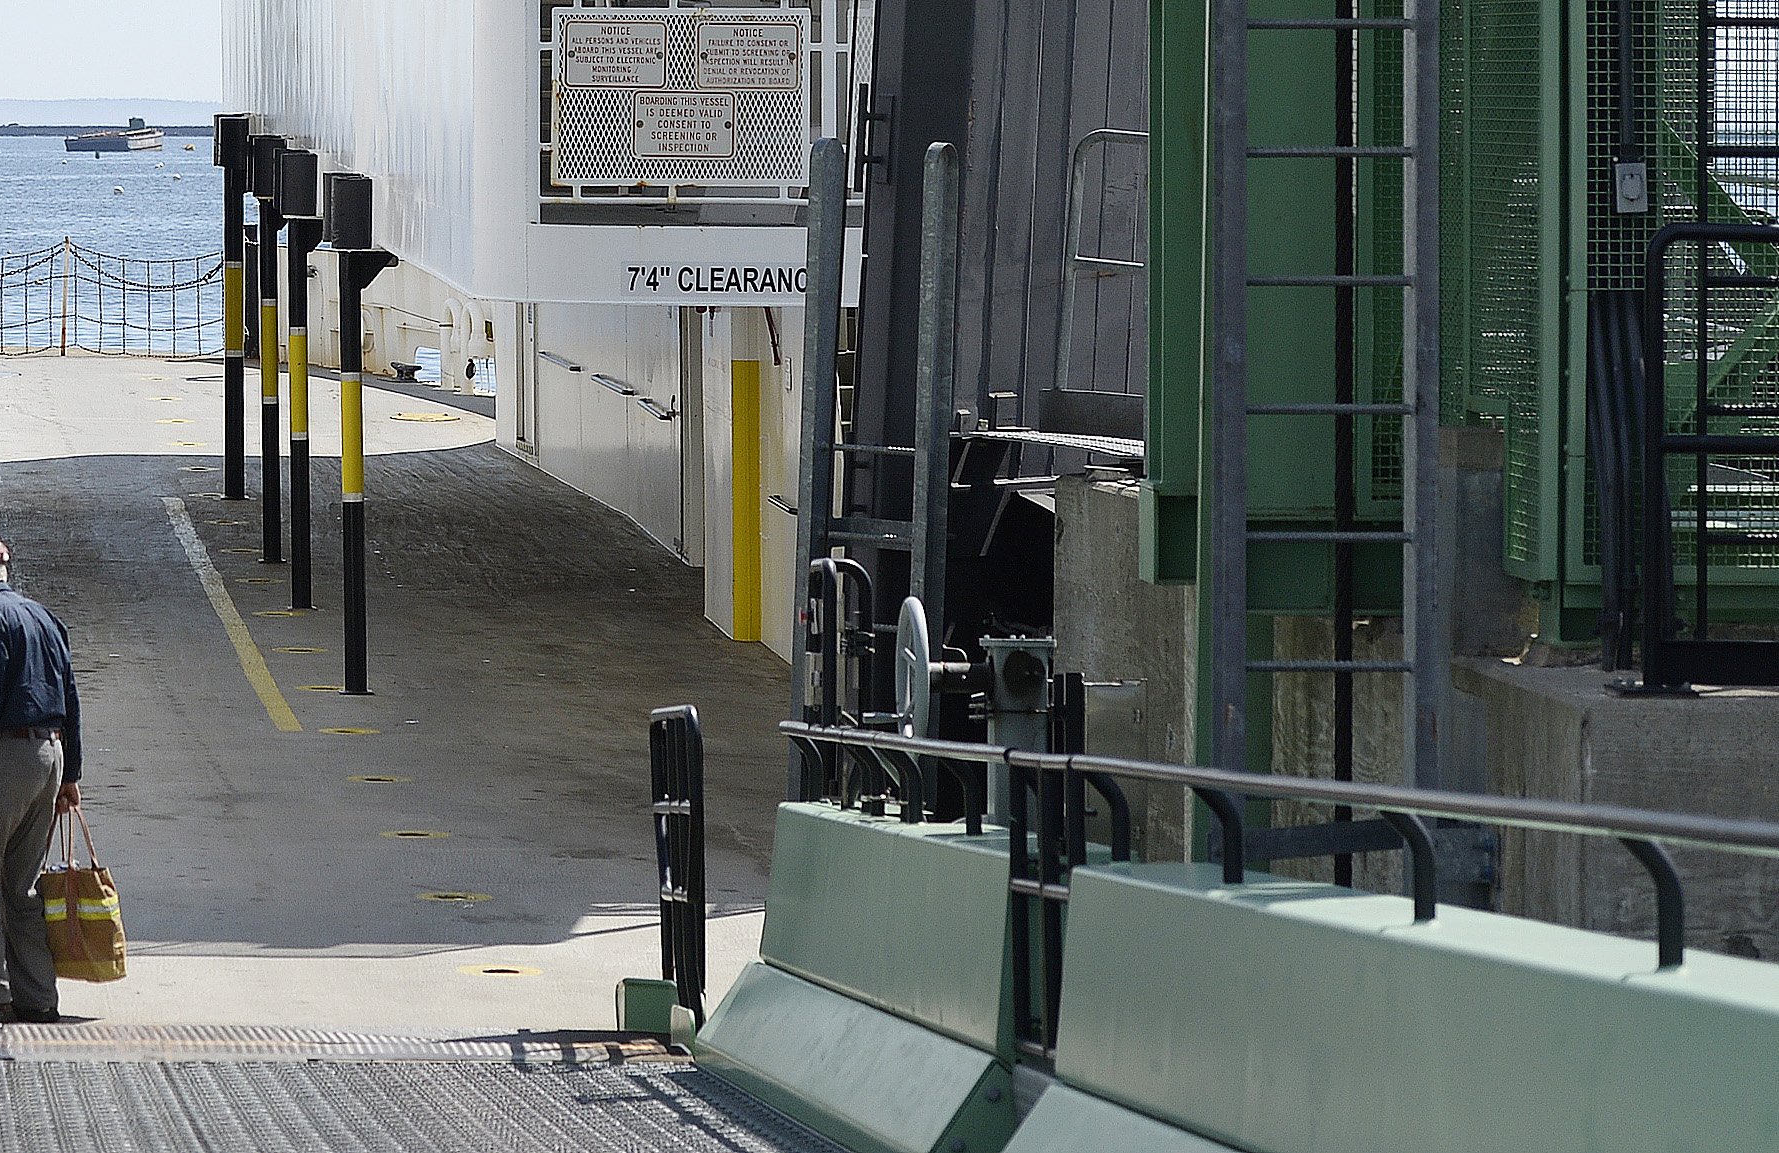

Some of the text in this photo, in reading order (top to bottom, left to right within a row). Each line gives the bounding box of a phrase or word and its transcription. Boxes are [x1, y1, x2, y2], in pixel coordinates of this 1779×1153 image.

[601, 27, 631, 35] NOTICE
[734, 29, 763, 37] NOTICE
[586, 37, 613, 45] PERSONS
[617, 56, 656, 64] ELECTRONIC
[592, 75, 639, 83] SURVEILLANCE
[640, 97, 728, 106] BOARDING THIS VESSEL
[660, 109, 695, 117] DEEMED
[658, 120, 710, 129] CONSENT TO
[651, 132, 717, 140] SCREENING OR
[628, 266, 807, 292] 7'4" CLEARANC
